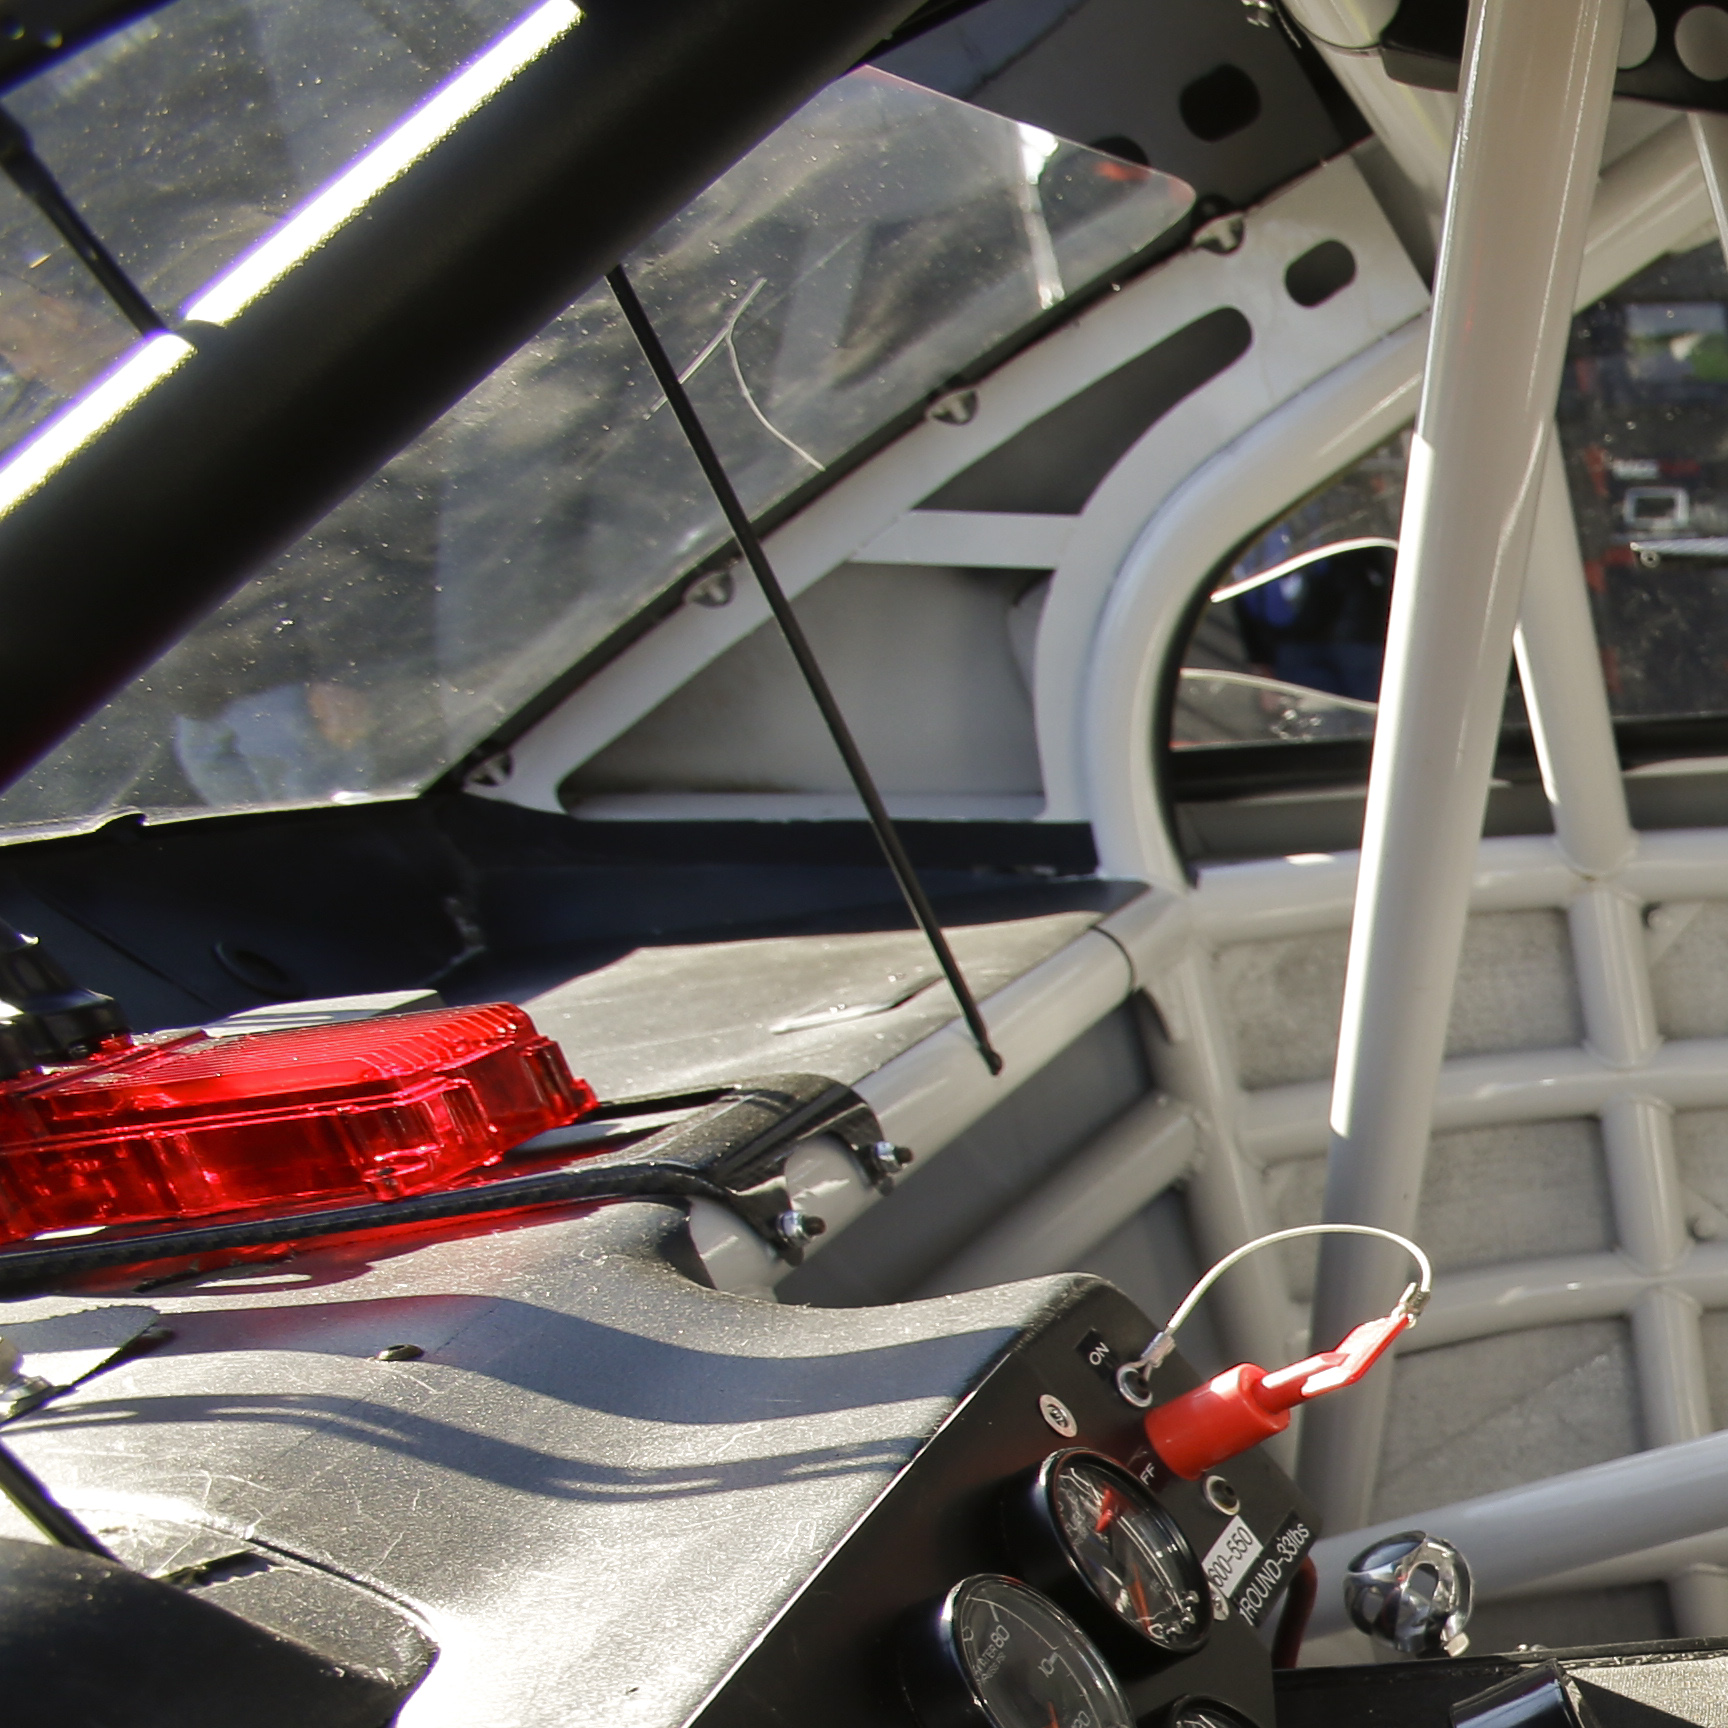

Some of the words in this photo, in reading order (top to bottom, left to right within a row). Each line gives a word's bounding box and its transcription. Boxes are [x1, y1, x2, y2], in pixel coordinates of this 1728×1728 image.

[1089, 1342, 1110, 1367] ON
[1140, 1462, 1156, 1486] FF
[990, 1624, 1011, 1649] 80
